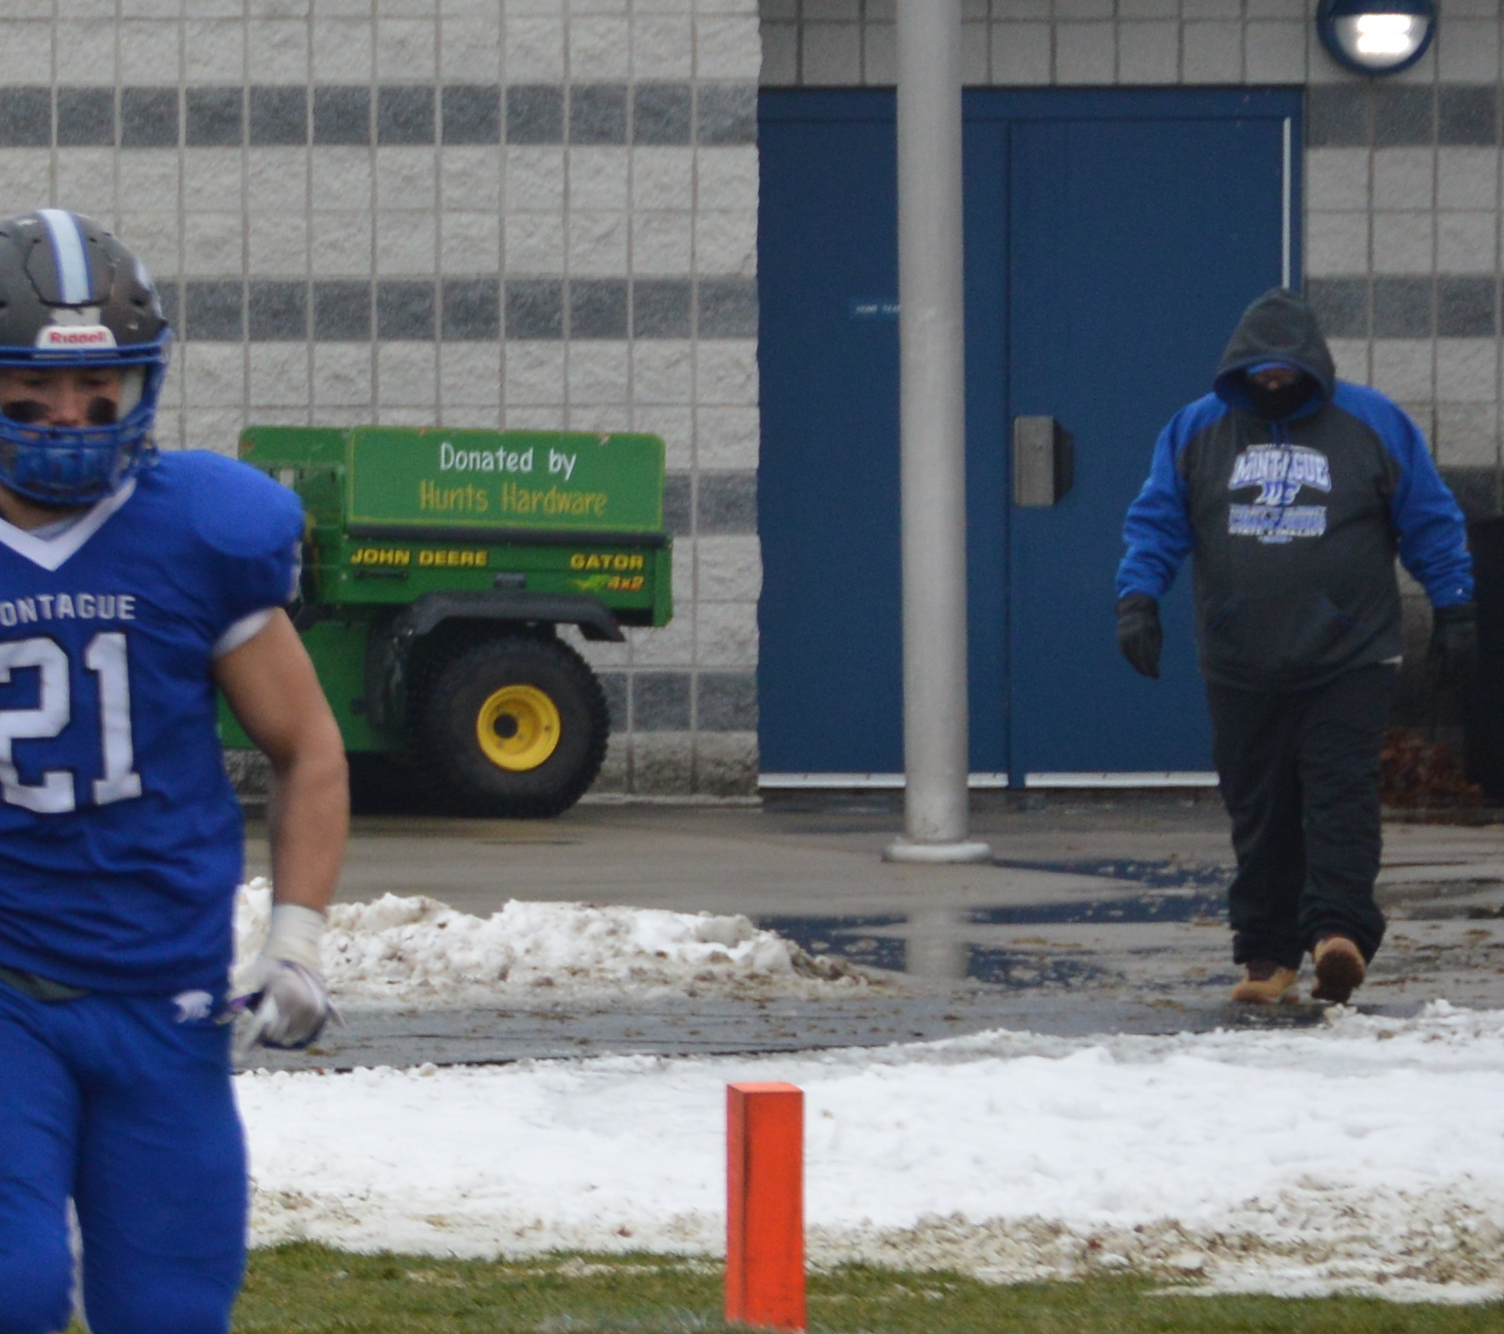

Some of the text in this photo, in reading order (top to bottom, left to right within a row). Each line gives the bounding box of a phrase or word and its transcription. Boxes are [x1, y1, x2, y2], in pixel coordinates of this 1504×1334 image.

[440, 442, 577, 482] Donated by
[419, 479, 608, 517] Hunts Hardware
[350, 548, 644, 571] JOHN DEERE GATOR
